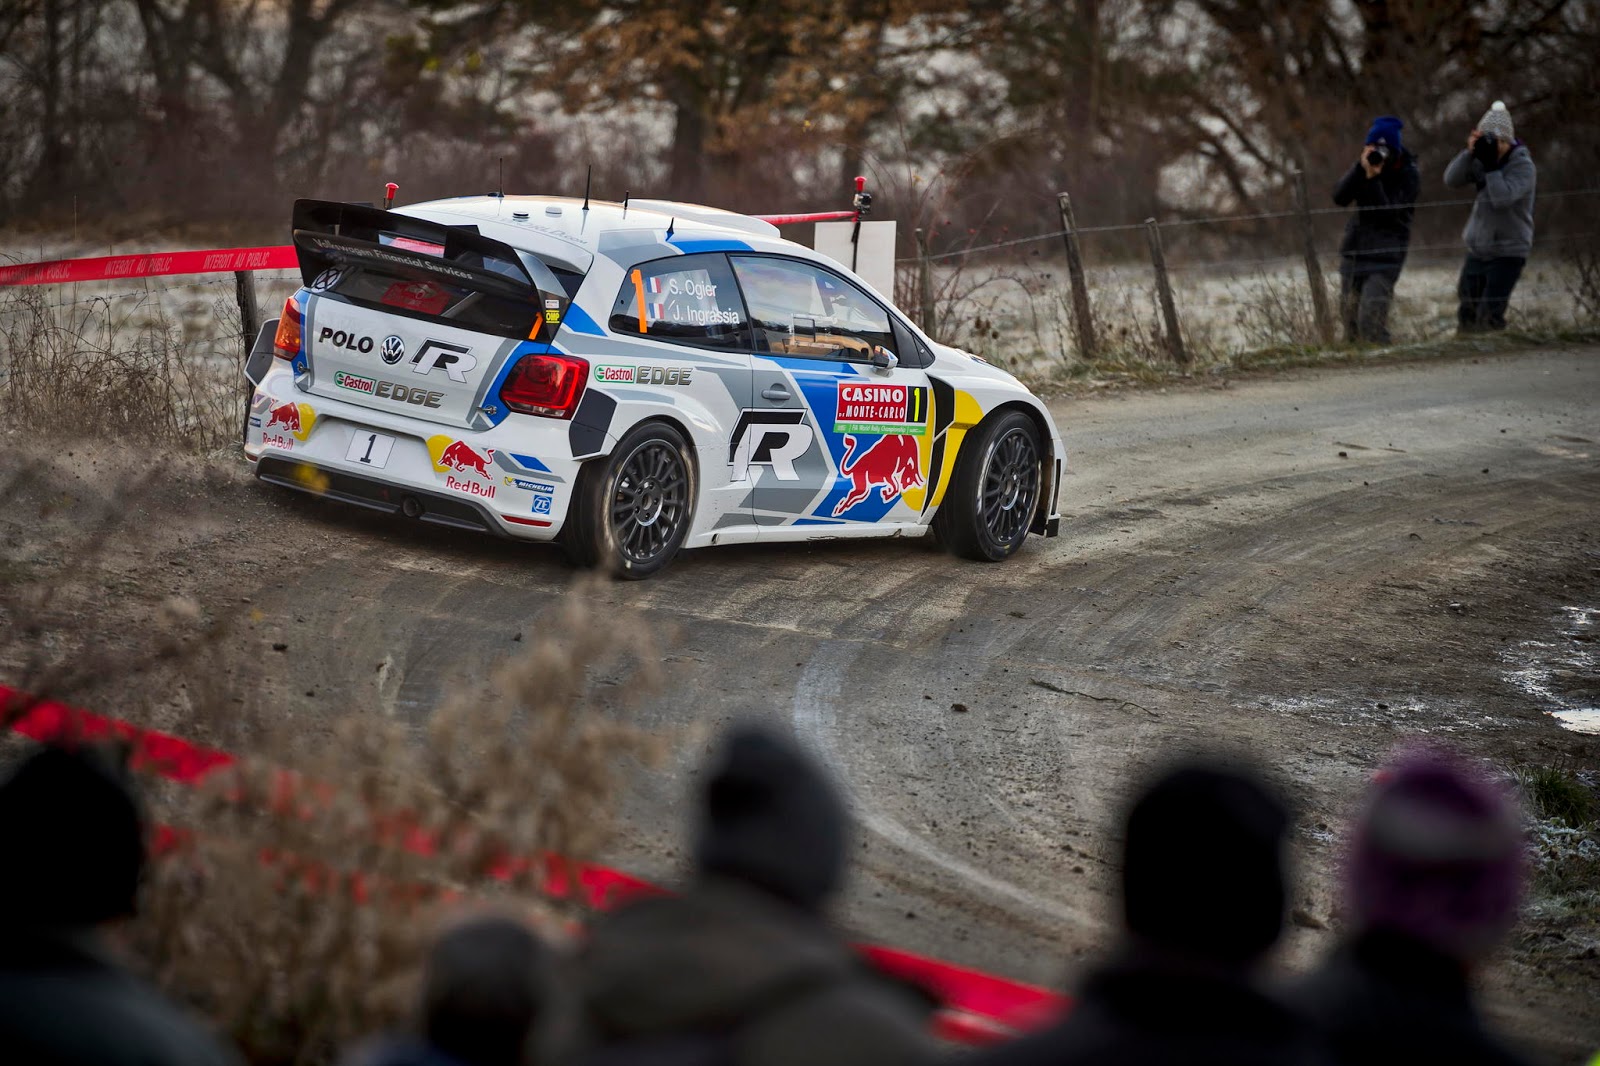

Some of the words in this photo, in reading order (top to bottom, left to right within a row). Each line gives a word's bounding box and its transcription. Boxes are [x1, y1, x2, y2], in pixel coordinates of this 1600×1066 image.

[104, 258, 136, 275] INTERDIT
[136, 258, 148, 274] AU
[148, 256, 173, 273] PUBLIC
[203, 253, 235, 270] INTERDIT
[234, 252, 247, 268] AU
[245, 251, 270, 268] PUBLIC
[312, 238, 374, 258] Volkswagen
[375, 249, 423, 267] Financial
[425, 261, 473, 280] Services
[669, 278, 682, 295] S.
[685, 279, 717, 300] Ogier
[630, 269, 648, 334] 1
[673, 304, 684, 321] J.
[687, 305, 740, 326] Ingrassia
[318, 327, 374, 353] POLO
[409, 337, 477, 384] R
[605, 366, 634, 382] Castrol
[636, 366, 693, 386] EDGE
[344, 375, 373, 393] Castrol
[375, 381, 445, 409] EDGE
[841, 387, 904, 403] CASINO
[846, 405, 904, 419] MONTE-CARLO
[914, 387, 921, 422] 1
[262, 432, 277, 446] Red
[277, 435, 294, 450] Bull
[360, 434, 377, 464] 1
[727, 408, 814, 482] R
[446, 475, 470, 496] Red
[470, 480, 496, 499] Bull
[518, 481, 554, 492] MICHELIN
